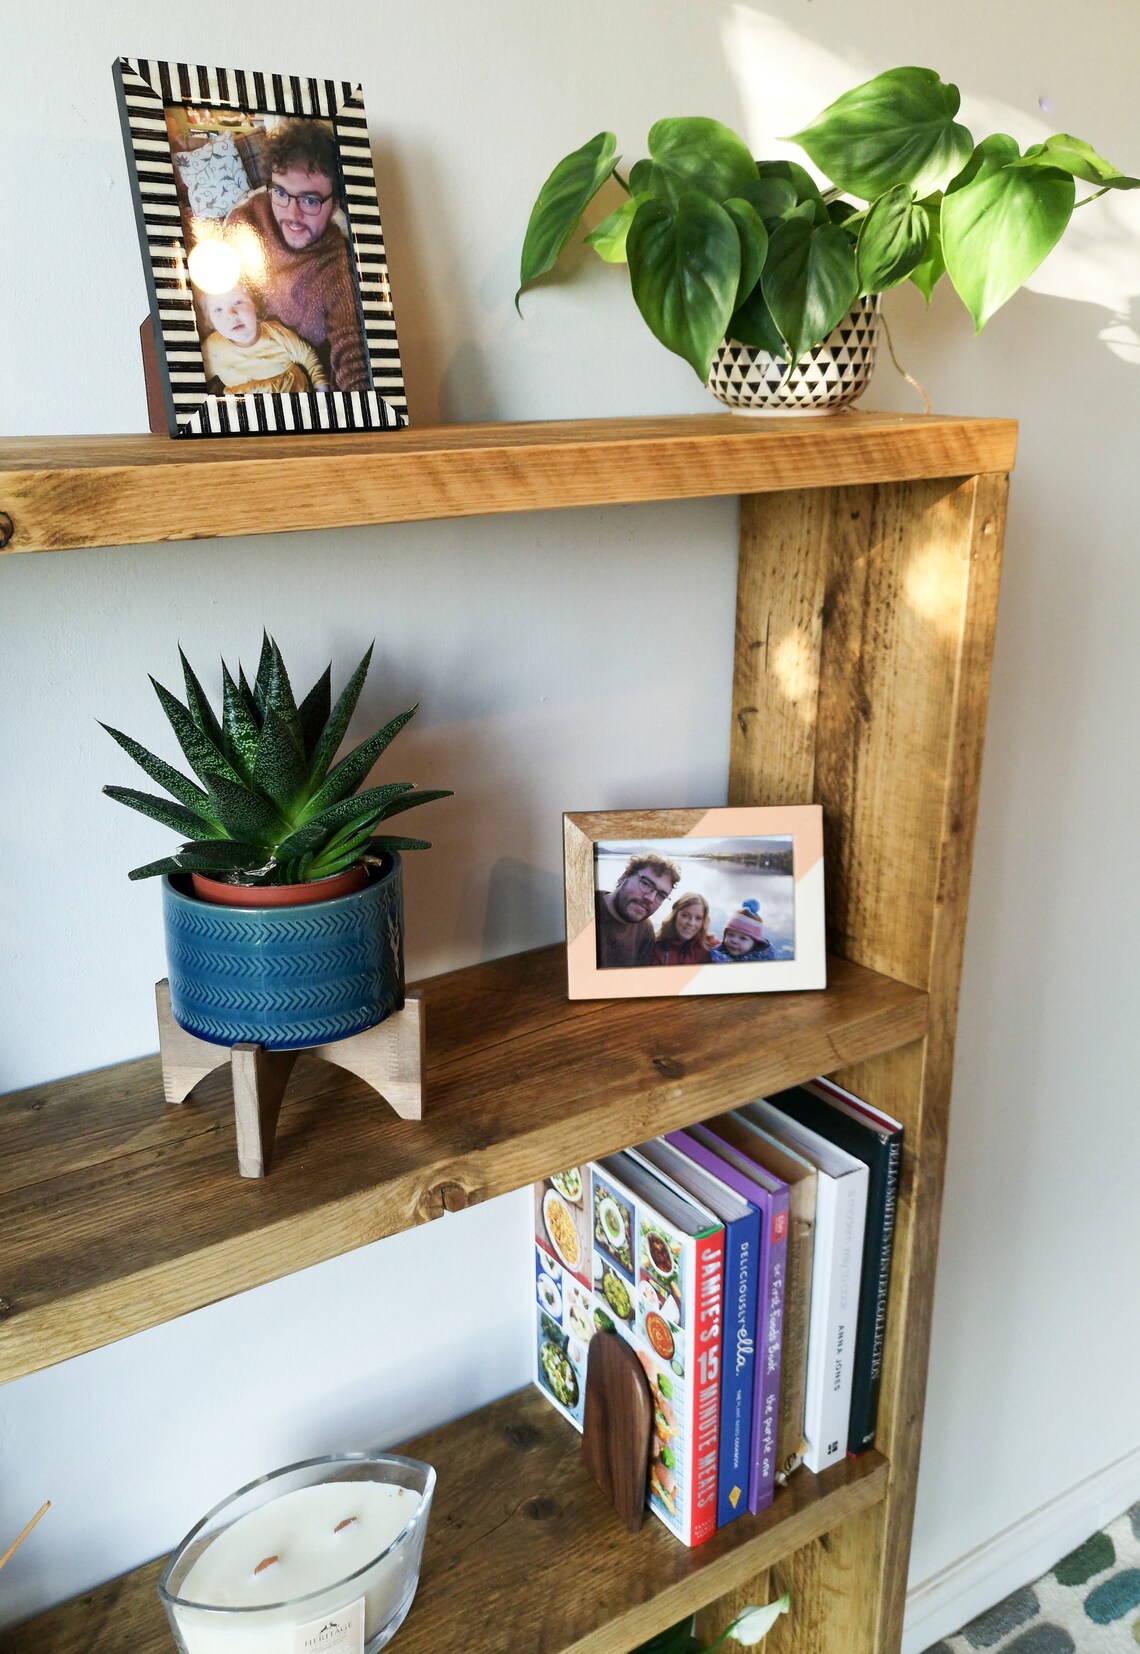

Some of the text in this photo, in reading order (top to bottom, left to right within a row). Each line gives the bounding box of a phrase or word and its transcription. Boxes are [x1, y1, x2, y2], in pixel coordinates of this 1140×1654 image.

[887, 1142, 900, 1184] DELIA
[700, 1248, 721, 1342] JAMIE'S
[738, 1242, 749, 1323] DELICIOUSLY
[878, 1244, 892, 1299] WINTER
[697, 1344, 719, 1385] 15
[833, 1325, 844, 1392] ANNA JONES
[870, 1299, 887, 1380] COLLECTION
[698, 1382, 718, 1451] MINUTE
[764, 1394, 776, 1415] the
[762, 1416, 774, 1454] purple
[697, 1450, 716, 1508] MEALS
[762, 1457, 770, 1478] one
[304, 1621, 352, 1647] HERITAGE
